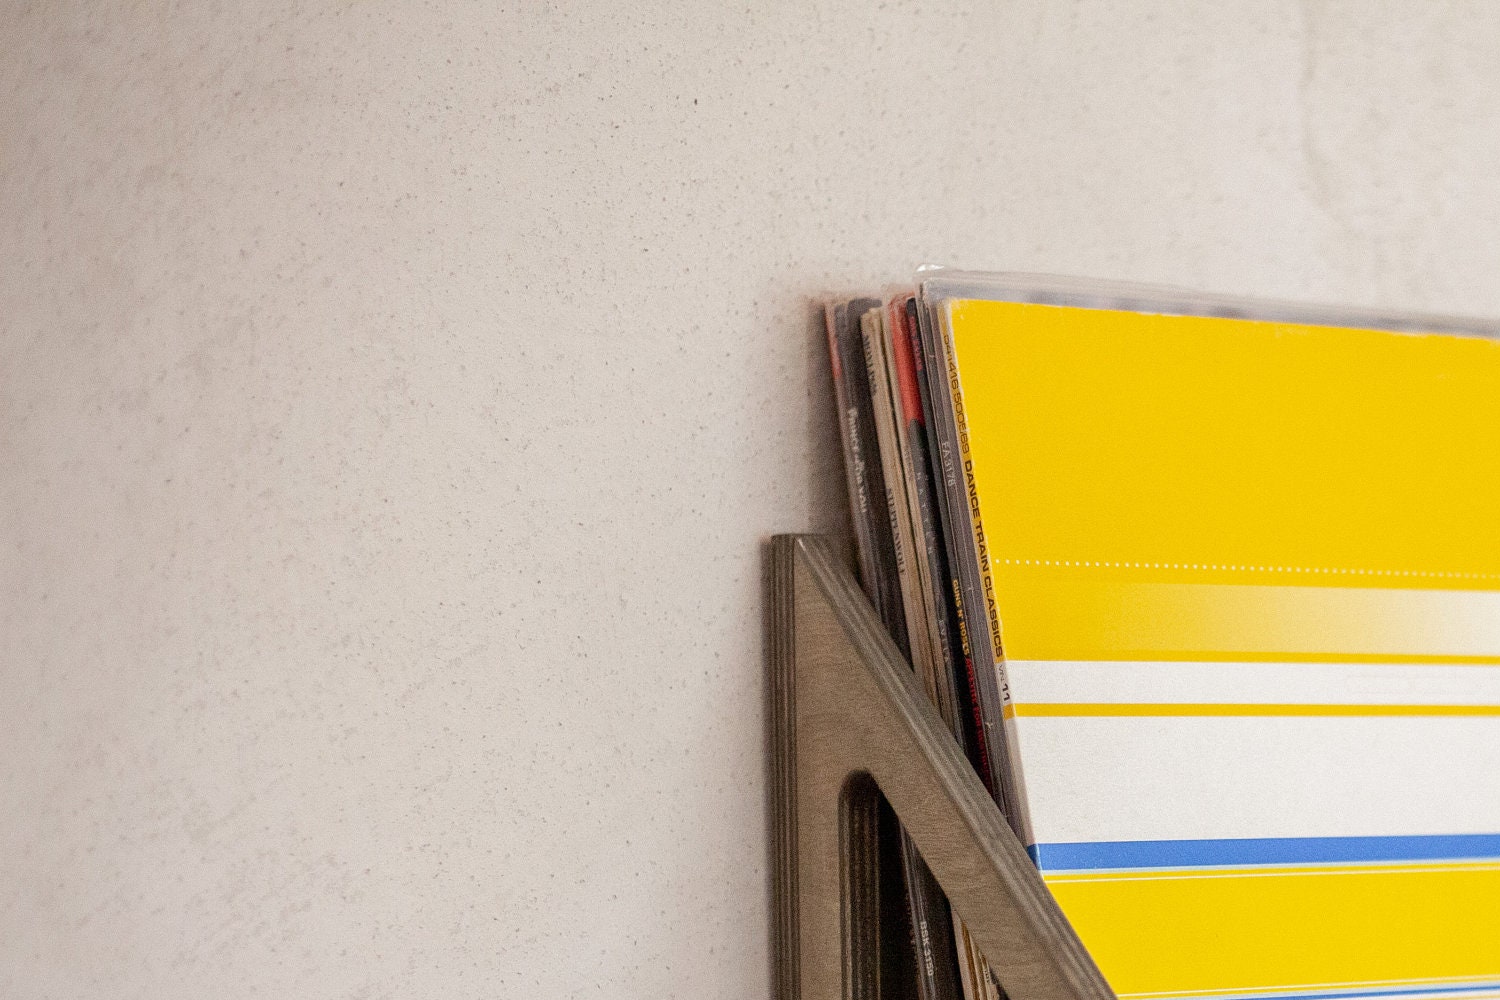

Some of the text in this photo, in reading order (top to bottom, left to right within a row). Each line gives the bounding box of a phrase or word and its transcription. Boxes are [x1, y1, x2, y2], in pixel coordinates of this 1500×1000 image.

[951, 579, 961, 607] GUNS
[958, 621, 970, 656] ROSES
[963, 460, 981, 518] DANCE
[973, 521, 990, 572] TRAIN
[982, 575, 1004, 657] CLASSICS
[1000, 683, 1010, 701] 11
